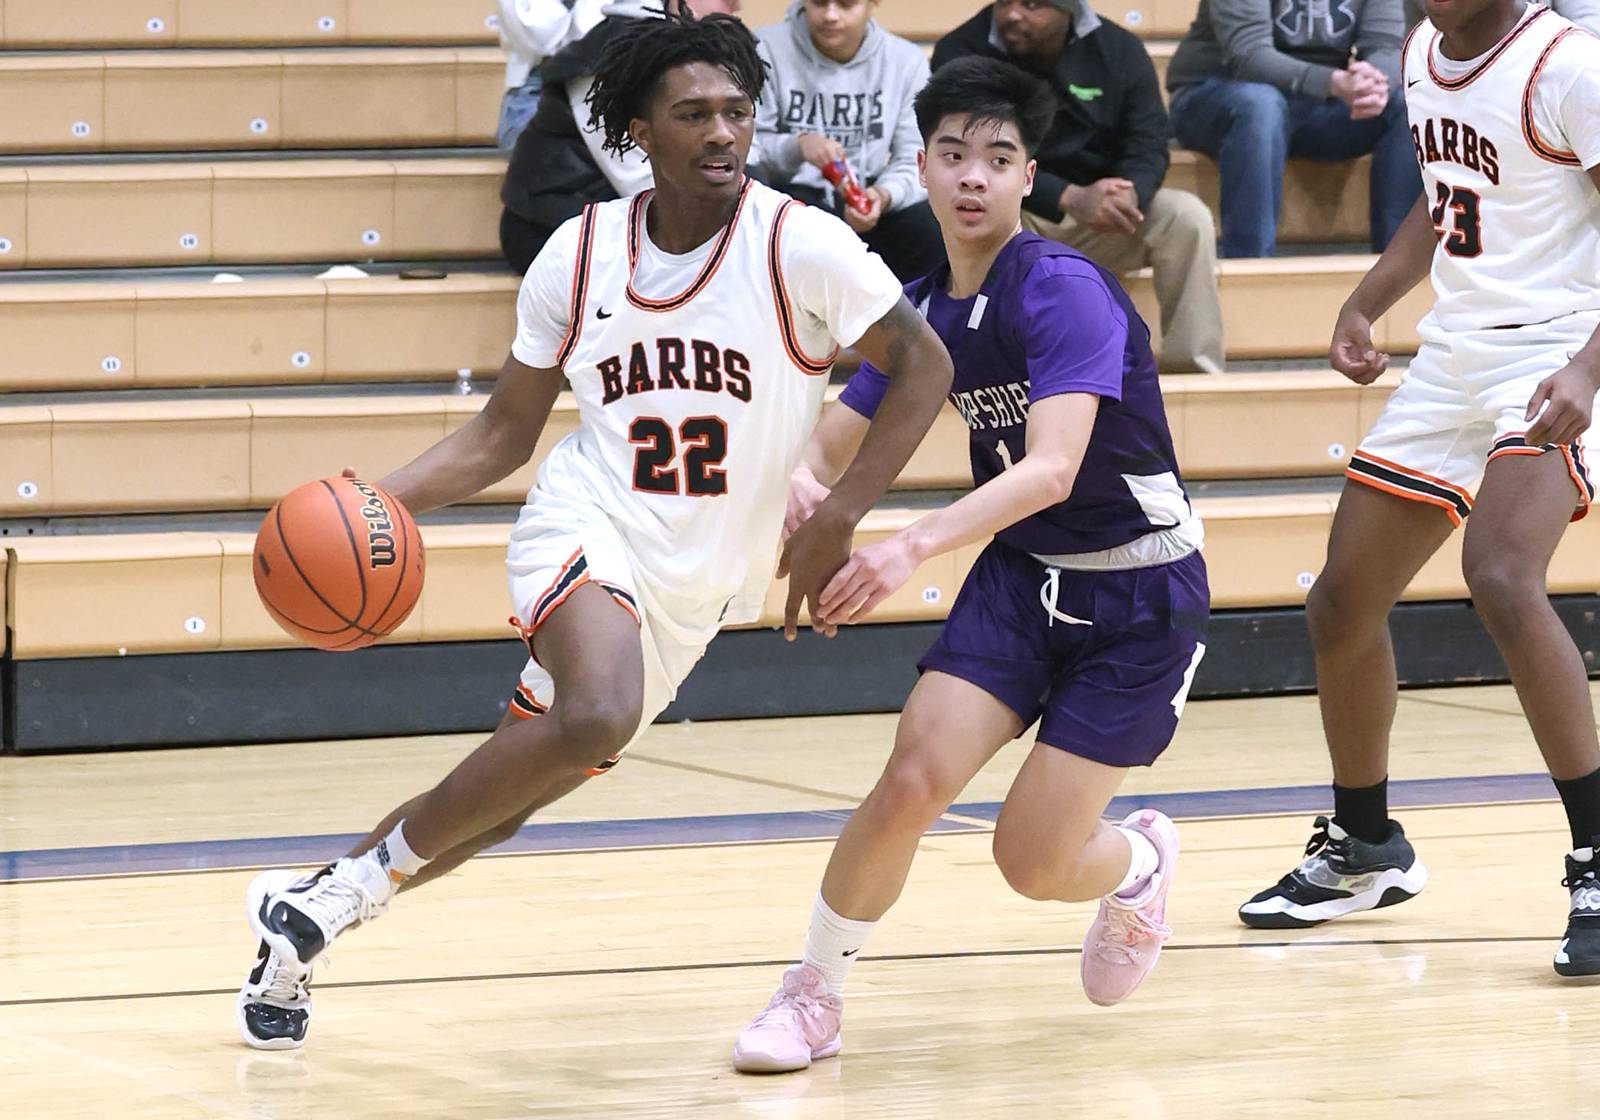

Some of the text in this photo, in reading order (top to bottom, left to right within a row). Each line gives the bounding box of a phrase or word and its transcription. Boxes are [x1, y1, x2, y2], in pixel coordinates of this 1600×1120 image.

[1410, 117, 1500, 186] BARBS
[1431, 180, 1483, 258] 23
[595, 337, 753, 406] BARBS
[628, 415, 729, 497] 22
